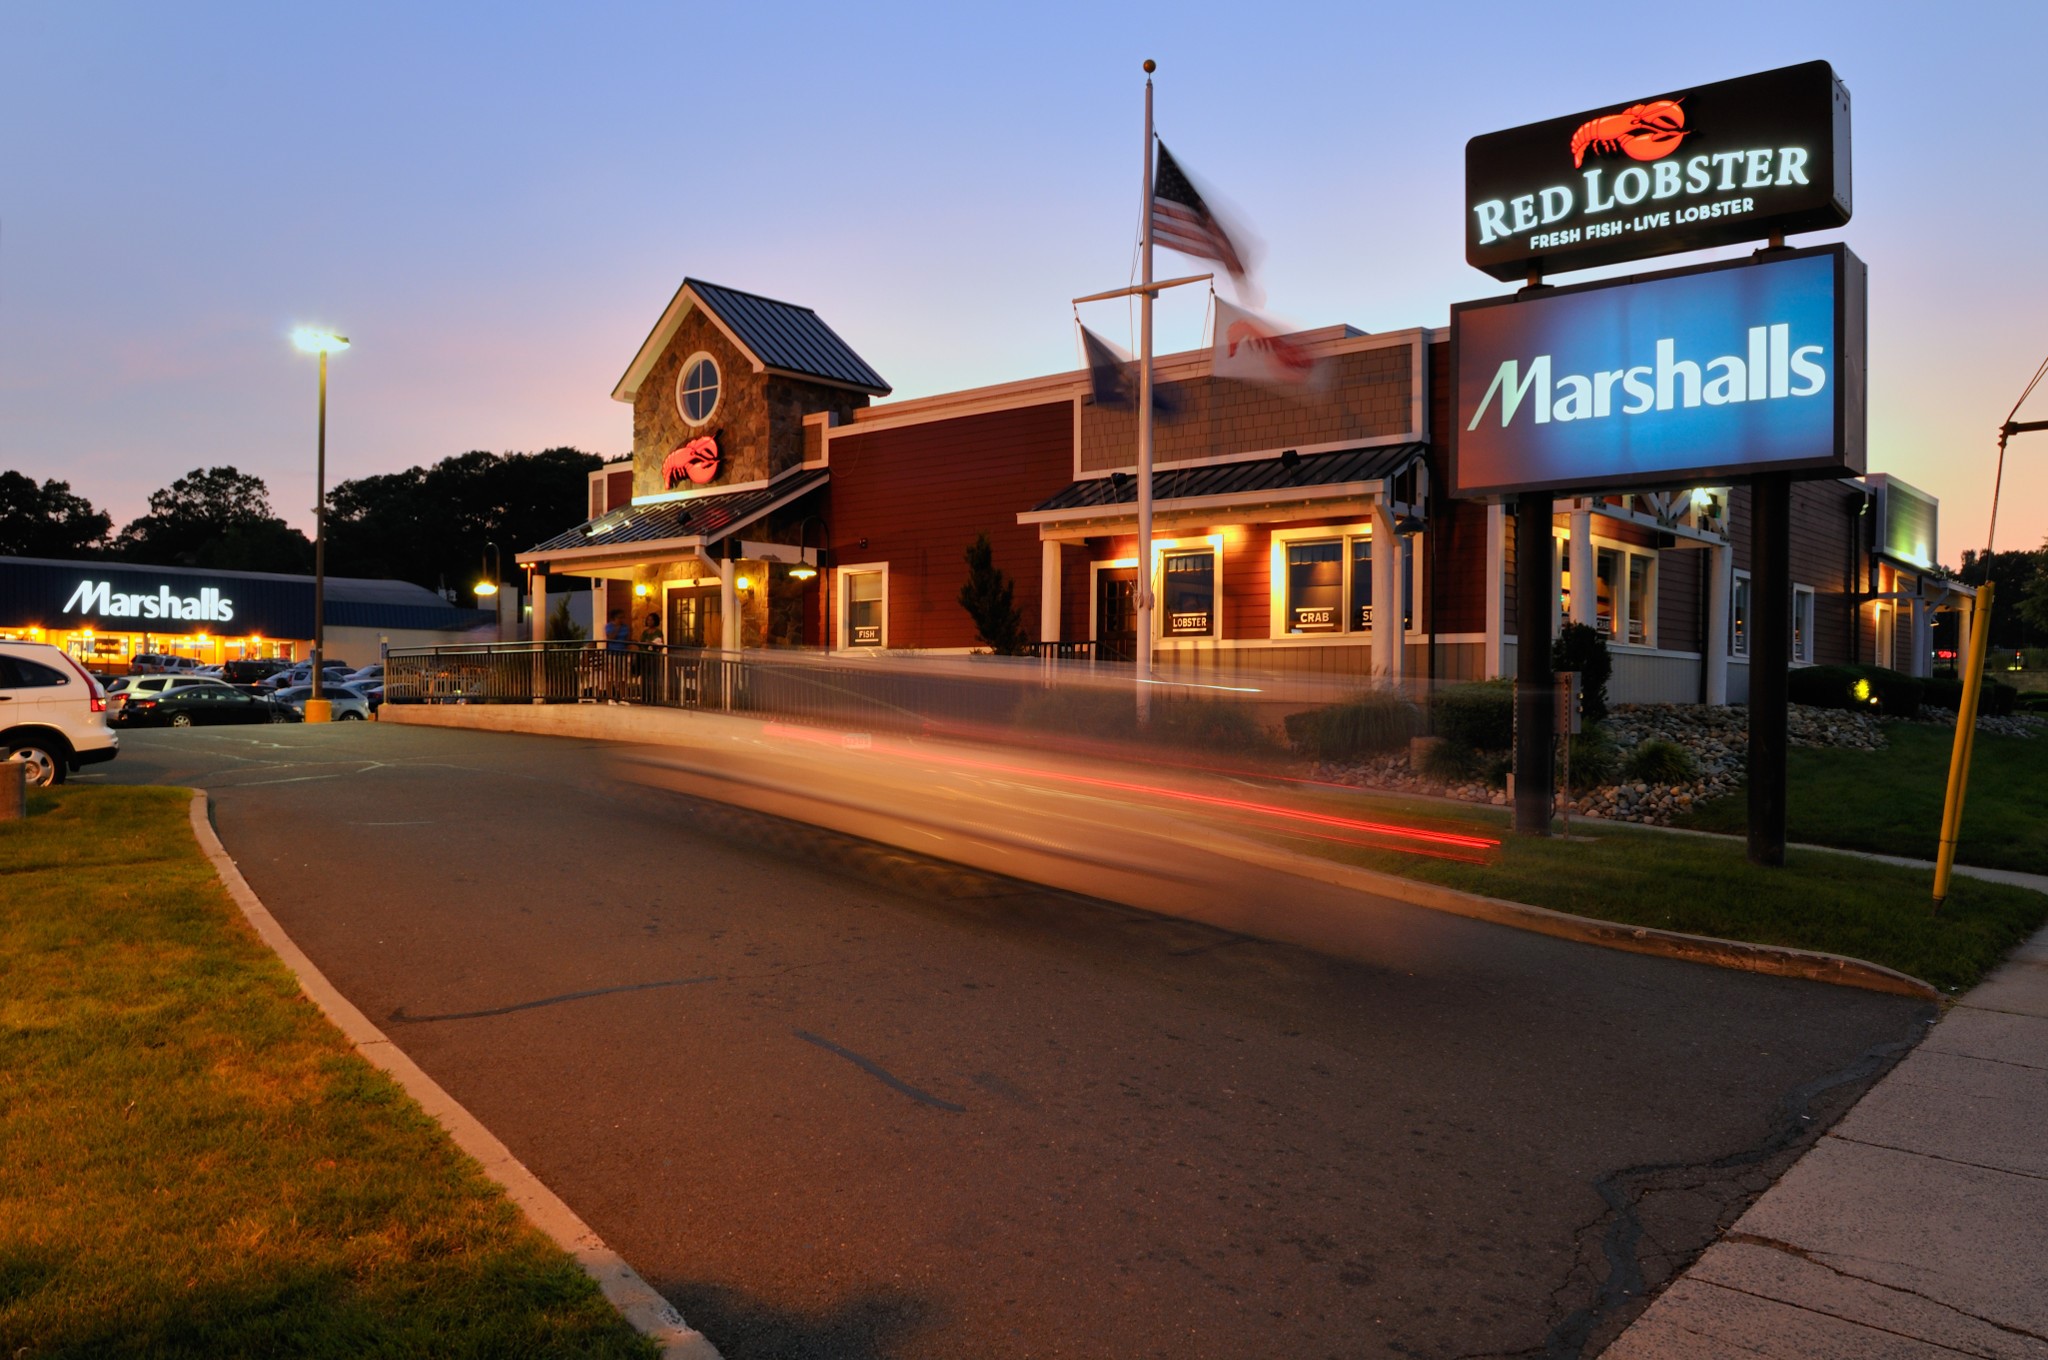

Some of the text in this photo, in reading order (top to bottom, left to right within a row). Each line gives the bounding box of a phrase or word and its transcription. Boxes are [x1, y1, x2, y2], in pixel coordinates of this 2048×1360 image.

[1473, 147, 1810, 245] RED LOBSTER
[1530, 197, 1754, 250] FRESH FISH LIVE LOBSTER
[1466, 323, 1826, 431] Marshalls
[62, 580, 234, 622] Marshalls
[1300, 612, 1330, 623] CRAB
[858, 630, 875, 638] FISH
[1172, 617, 1207, 628] LOBSTER
